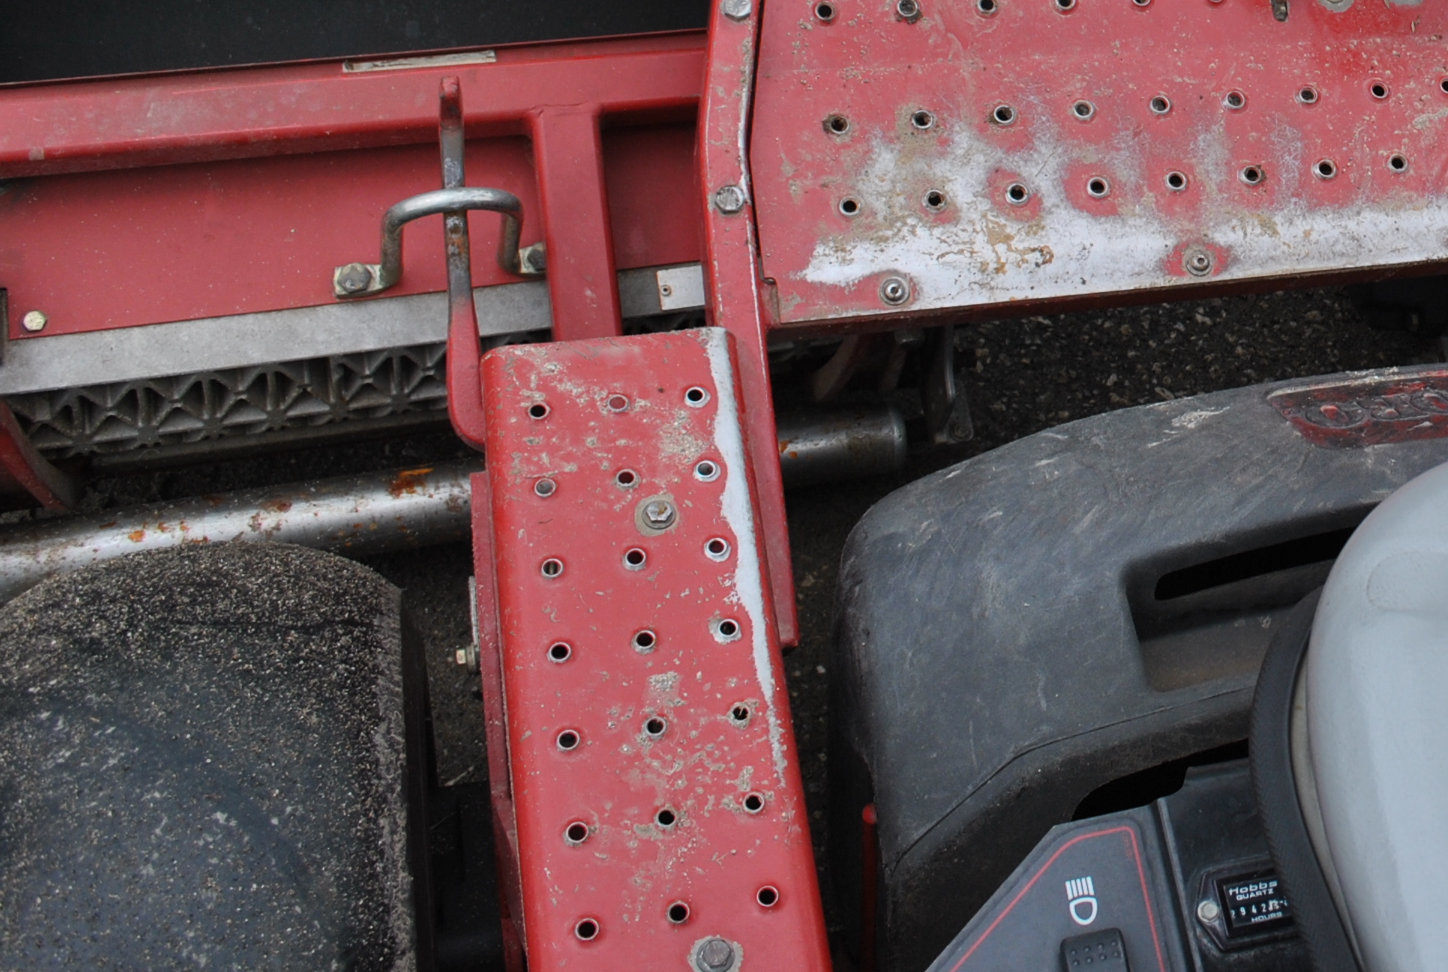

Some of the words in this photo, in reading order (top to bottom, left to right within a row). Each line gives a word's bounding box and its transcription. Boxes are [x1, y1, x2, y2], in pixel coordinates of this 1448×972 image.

[1228, 880, 1278, 896] Hobbs
[1236, 888, 1274, 901] QUARTZ
[1251, 911, 1283, 923] HOURS
